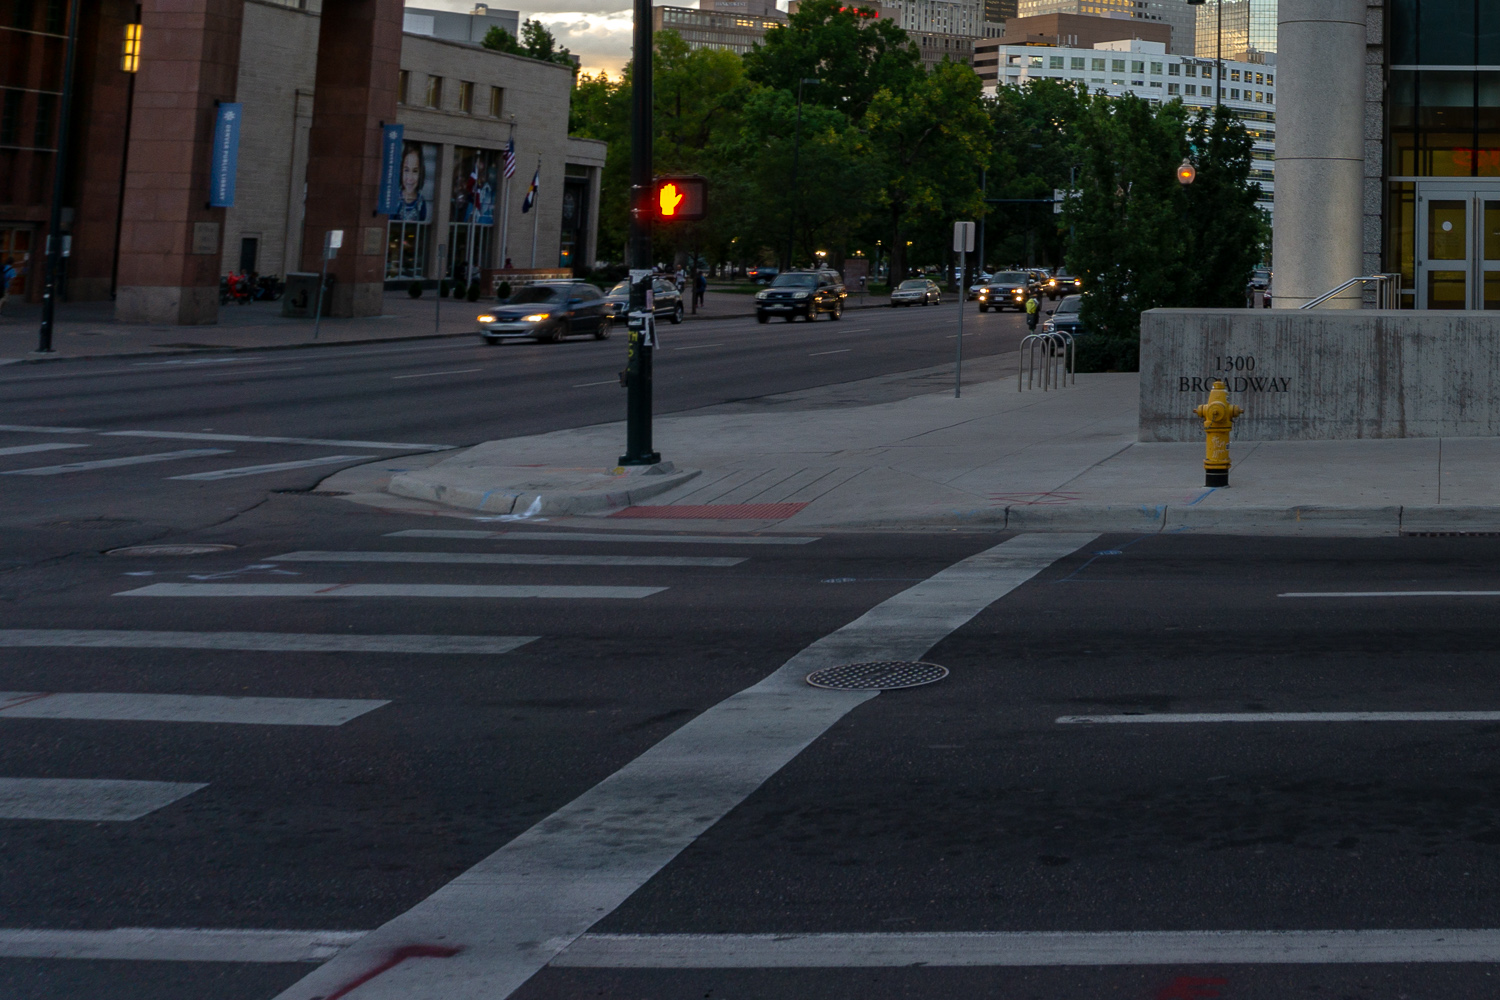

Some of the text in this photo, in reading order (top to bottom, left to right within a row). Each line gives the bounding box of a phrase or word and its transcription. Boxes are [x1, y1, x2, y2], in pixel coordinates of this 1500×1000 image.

[219, 124, 232, 200] DENVER PUBLIC LIBRARY
[1215, 355, 1256, 372] 1300
